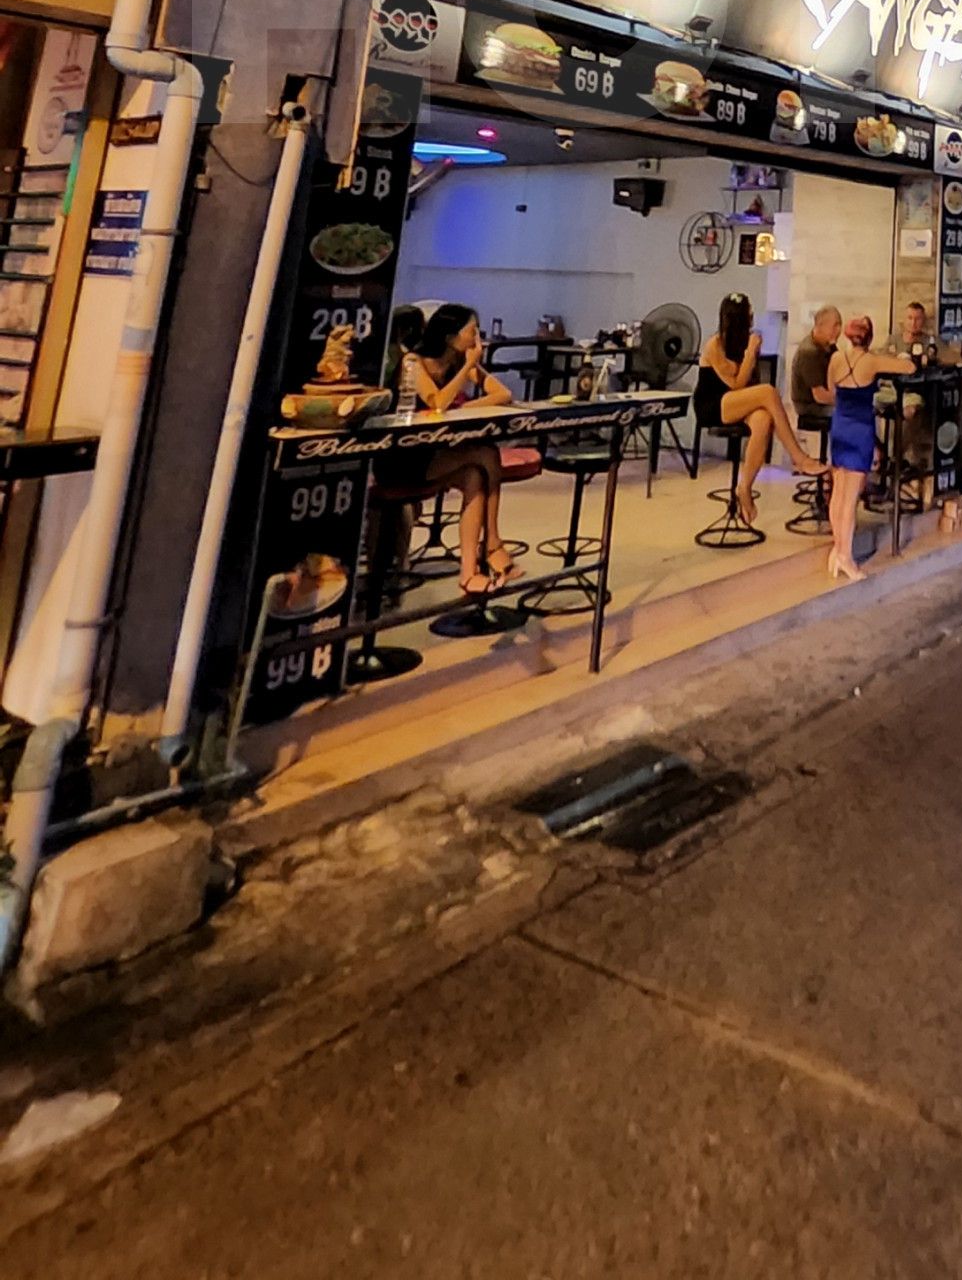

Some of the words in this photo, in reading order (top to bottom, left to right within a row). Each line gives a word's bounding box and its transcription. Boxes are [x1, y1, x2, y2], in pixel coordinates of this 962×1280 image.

[574, 67, 598, 94] 69
[716, 99, 734, 122] 89
[813, 120, 827, 141] 79
[296, 433, 393, 460] Black
[398, 422, 502, 449] Angel's
[505, 409, 619, 435] Restaurant
[619, 408, 634, 426] &
[641, 402, 682, 419] Bar
[290, 484, 328, 522] 99
